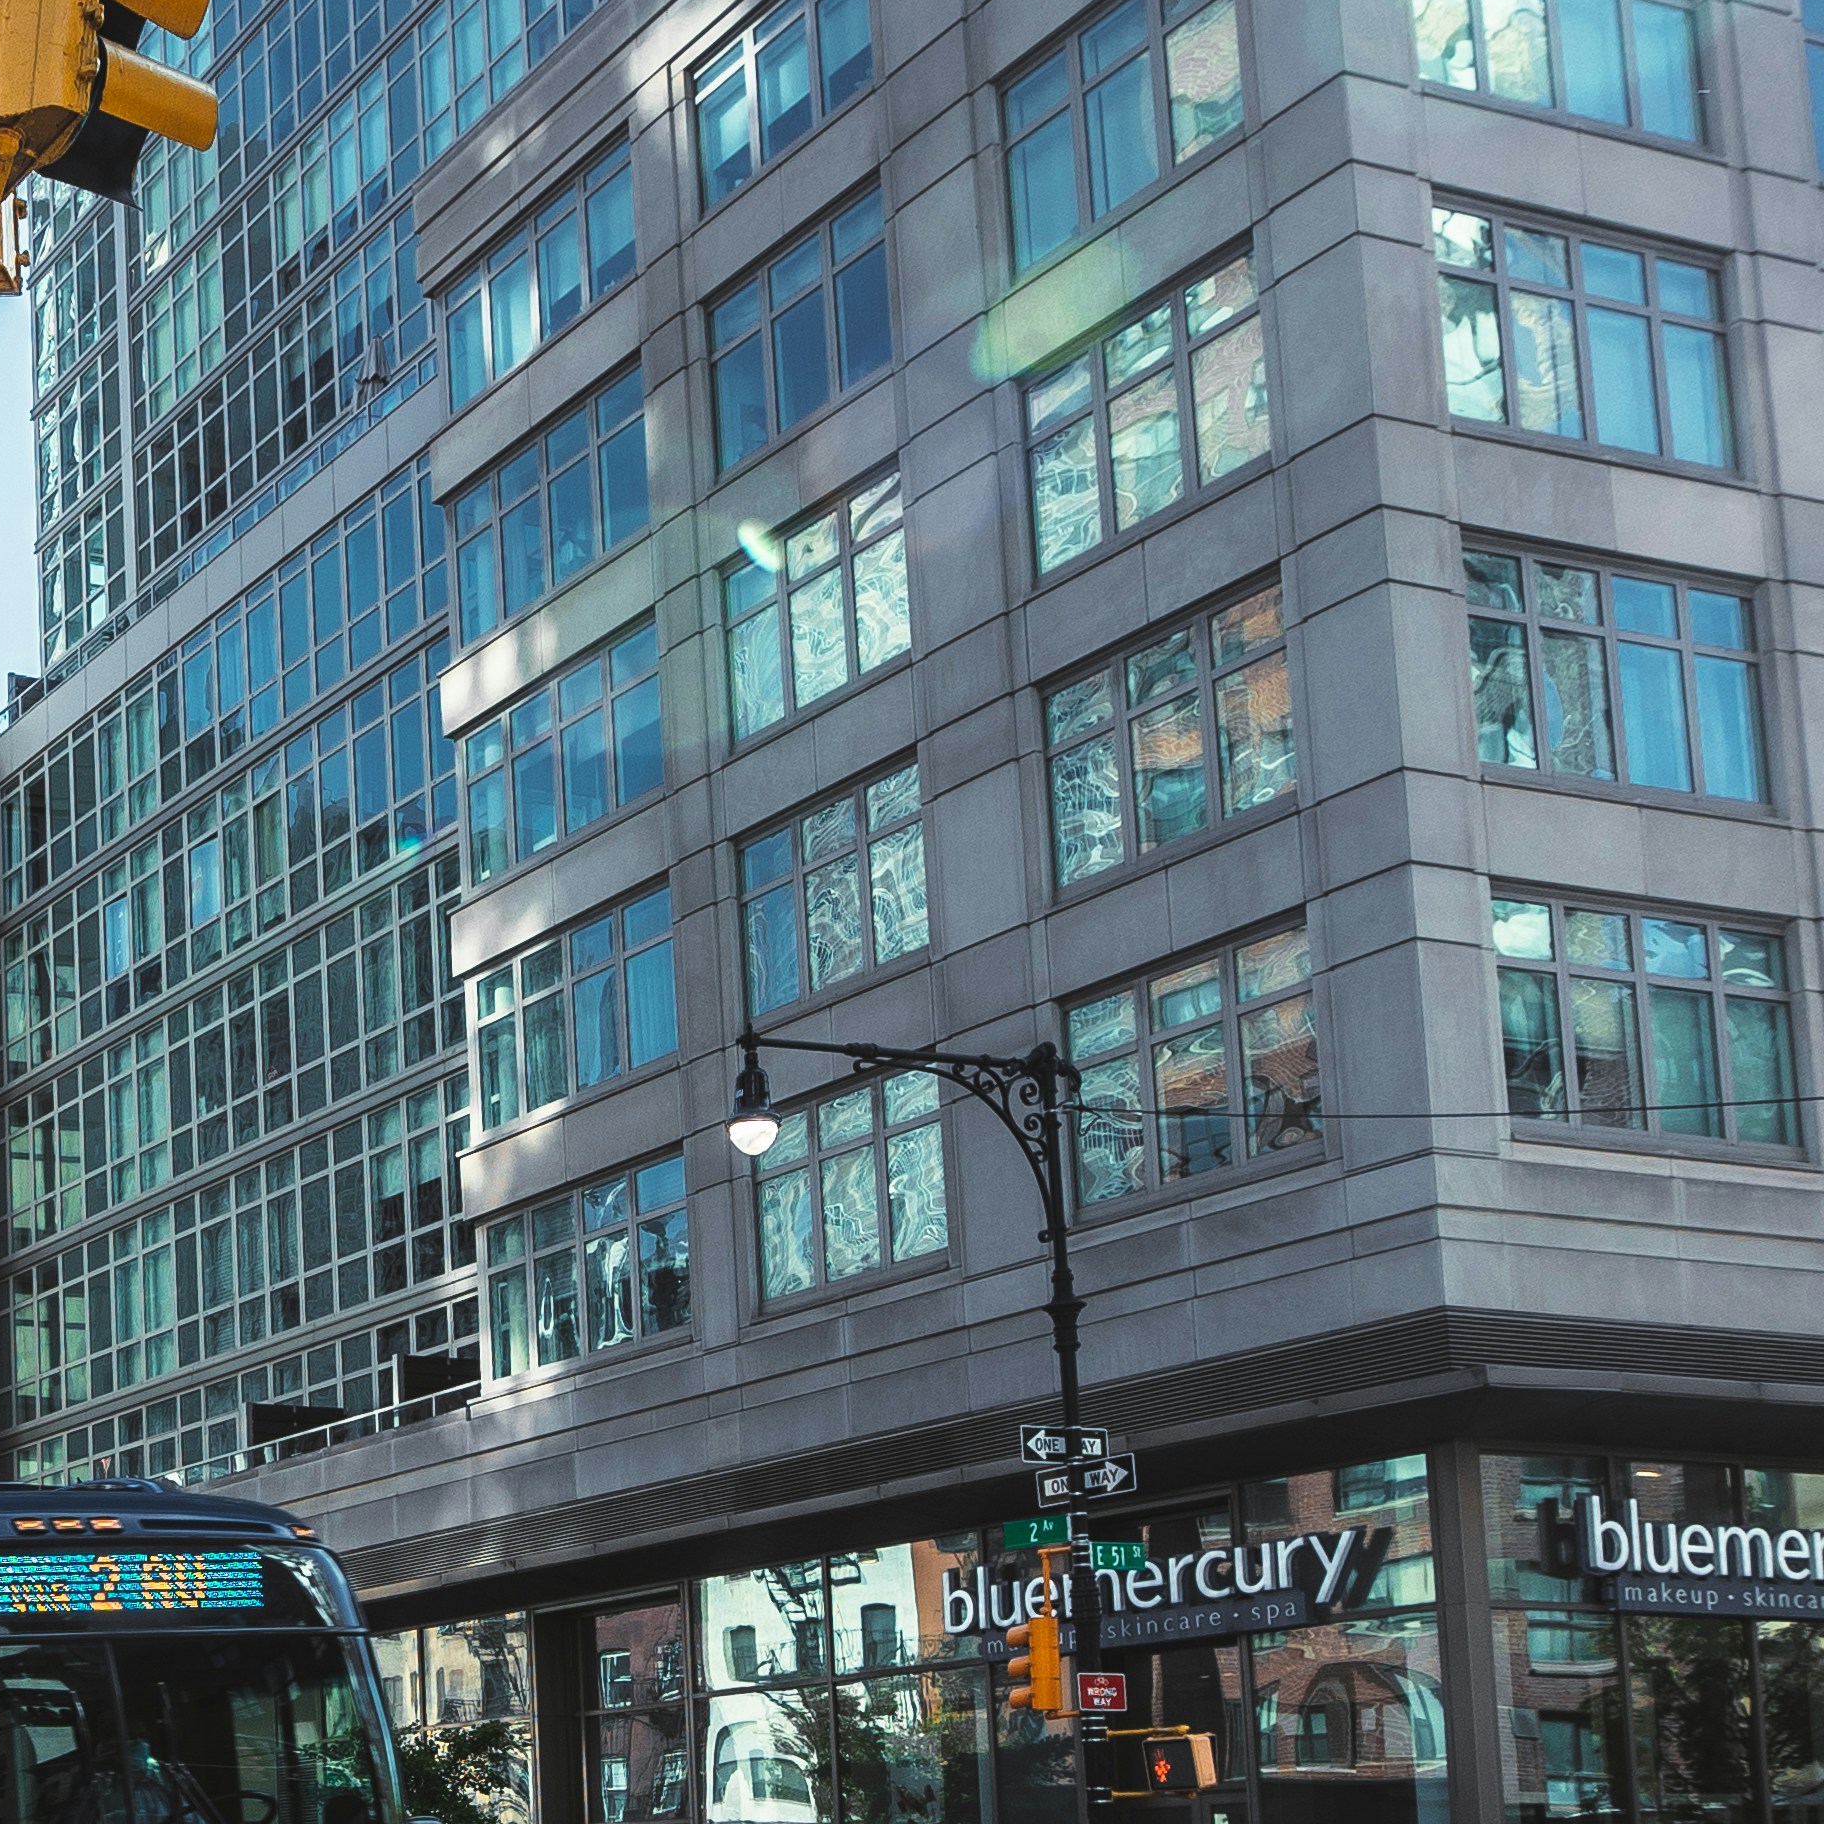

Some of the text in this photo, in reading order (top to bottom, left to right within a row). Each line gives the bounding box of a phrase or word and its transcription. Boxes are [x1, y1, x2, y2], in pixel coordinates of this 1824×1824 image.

[1035, 1437, 1096, 1453] ONE AY
[1051, 1469, 1119, 1493] ON WAY
[1029, 1523, 1038, 1542] 2
[1096, 1546, 1104, 1565] E
[1111, 1546, 1125, 1566] 51
[1625, 1582, 1719, 1610] makeup
[1107, 1610, 1222, 1639] skincare
[1251, 1601, 1297, 1625] spa
